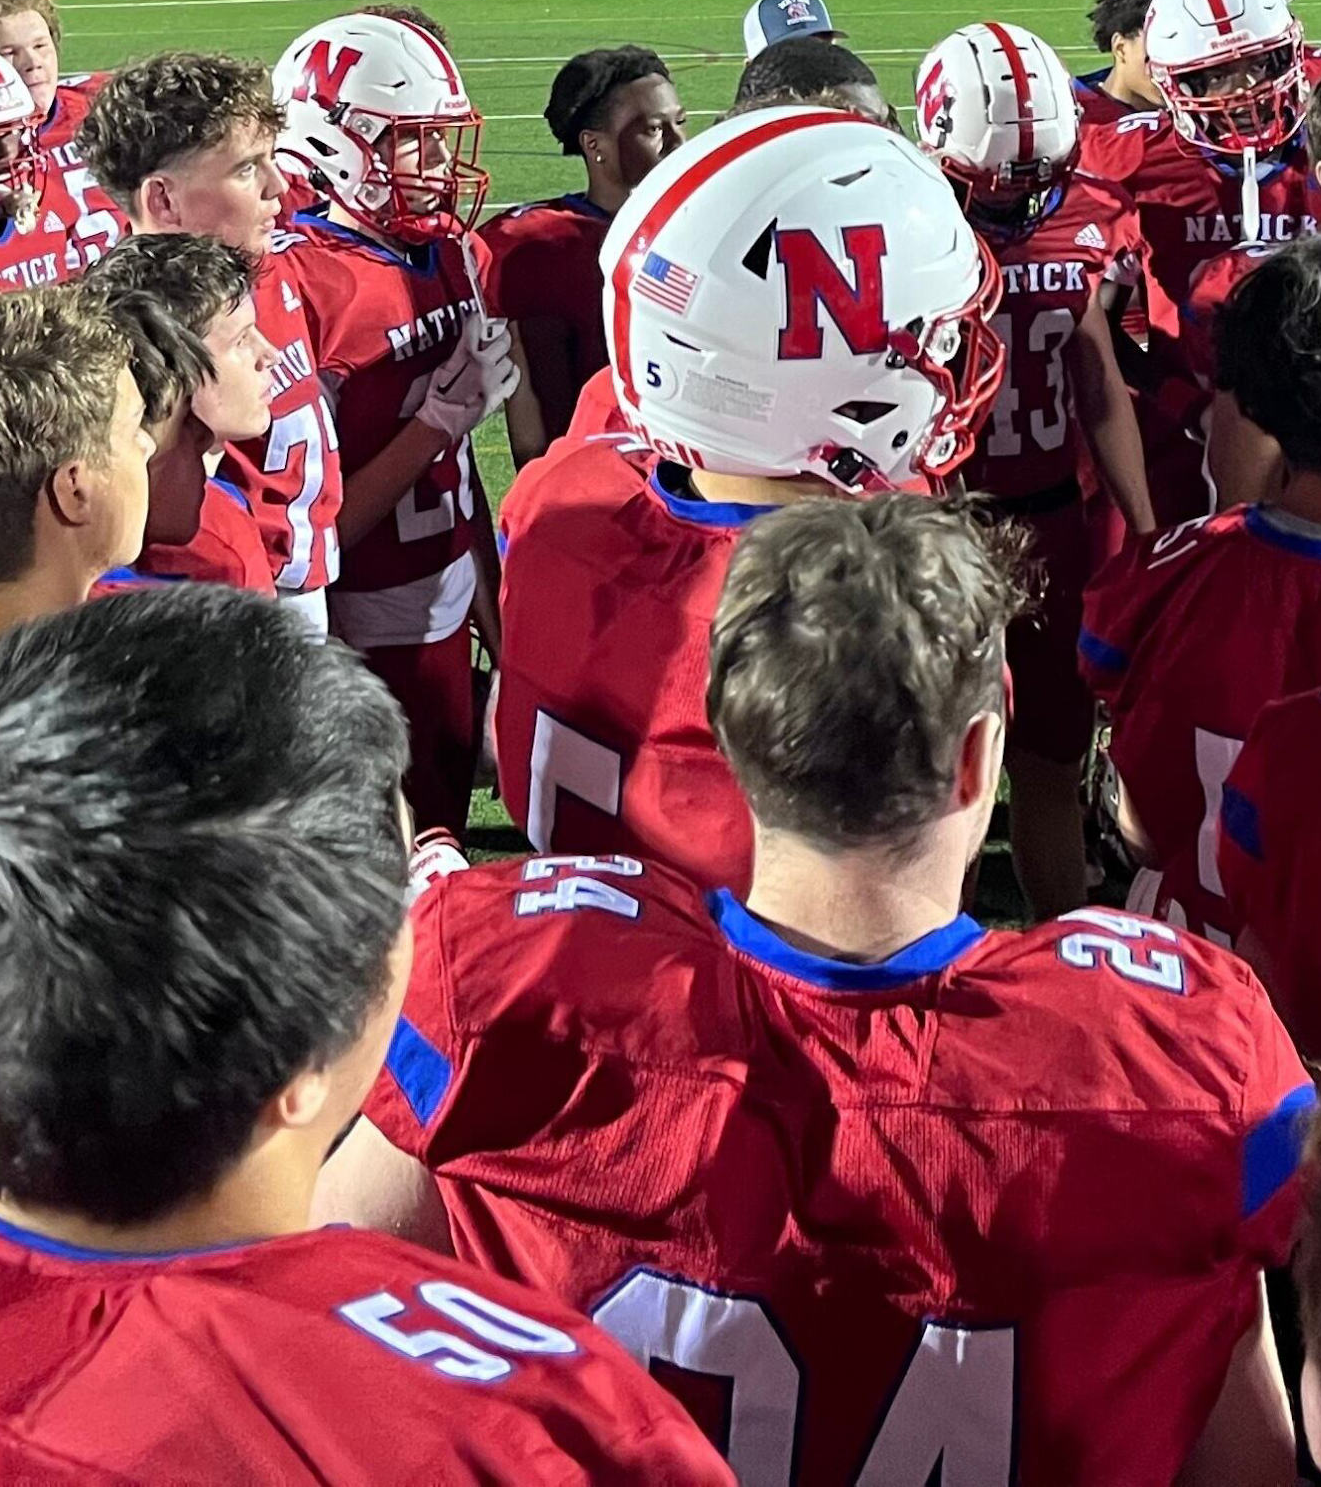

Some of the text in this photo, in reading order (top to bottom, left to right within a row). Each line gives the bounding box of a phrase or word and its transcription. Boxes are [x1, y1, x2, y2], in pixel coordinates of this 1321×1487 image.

[292, 39, 363, 111] N
[778, 224, 889, 361] N
[1001, 262, 1085, 294] TICK
[646, 360, 662, 388] 5
[987, 308, 1075, 457] 13
